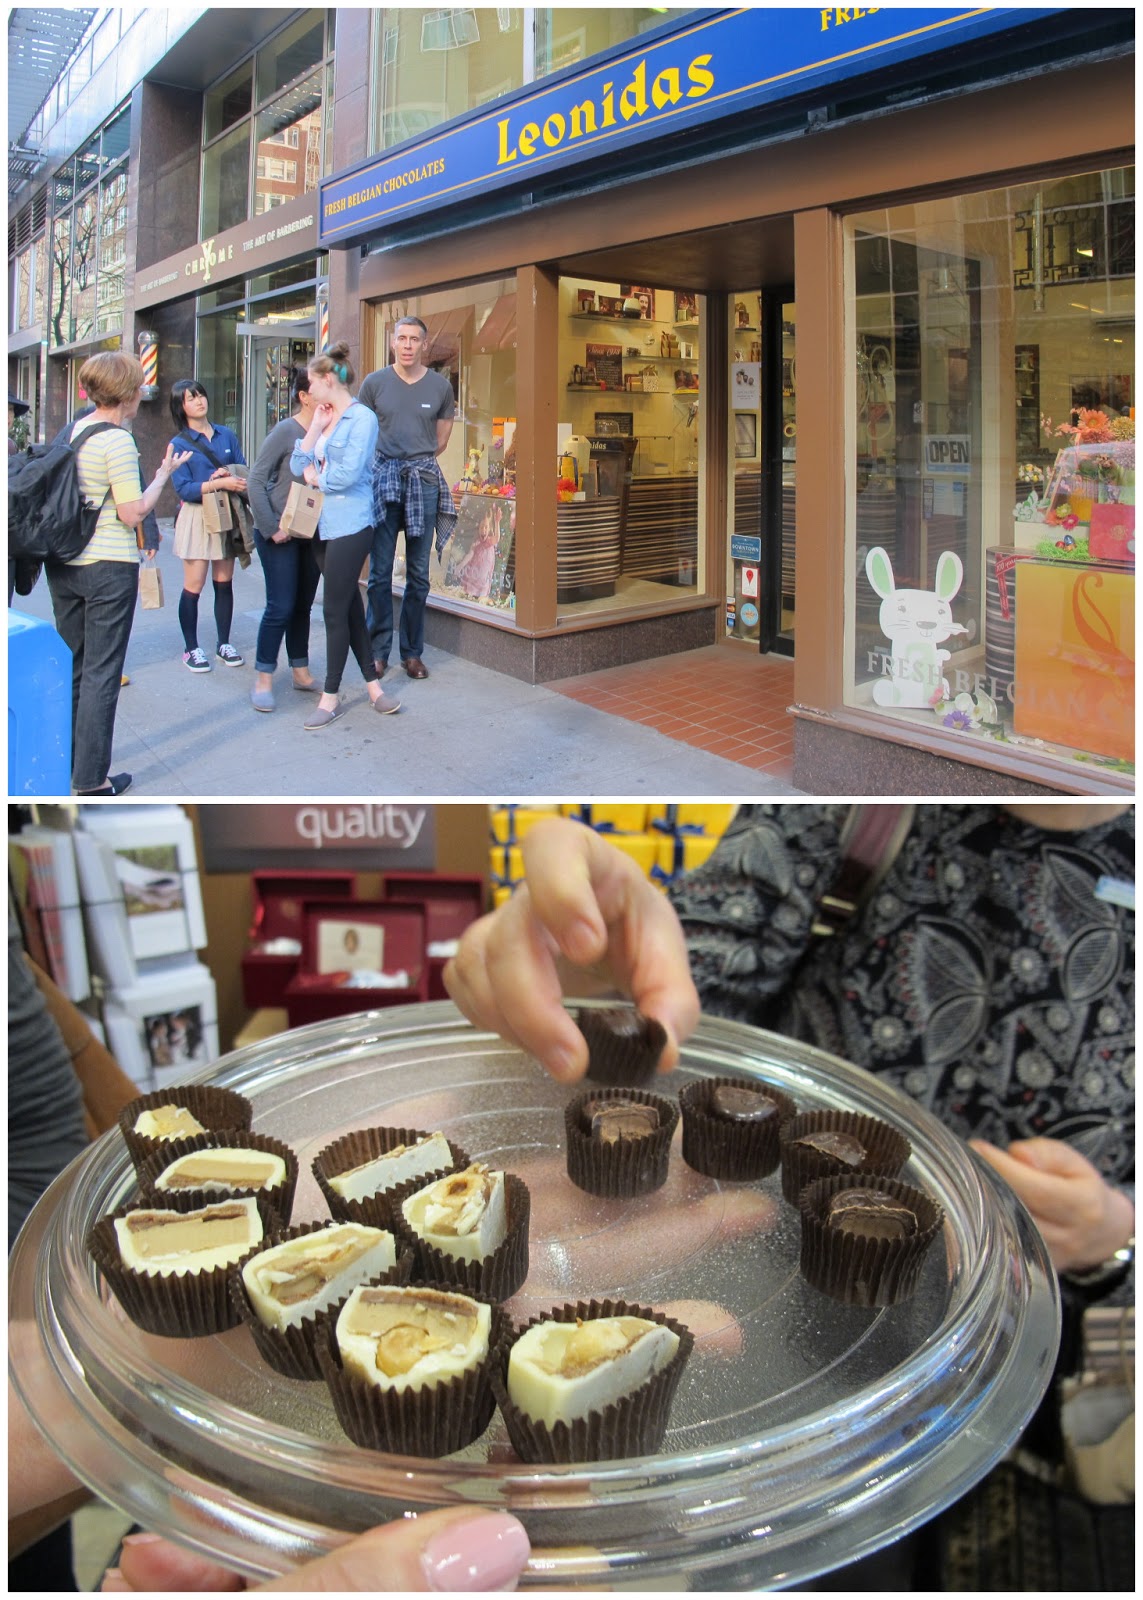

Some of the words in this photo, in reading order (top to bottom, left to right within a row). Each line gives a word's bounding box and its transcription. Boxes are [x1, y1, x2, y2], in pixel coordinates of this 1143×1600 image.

[820, 8, 880, 32] FRE
[496, 54, 715, 166] Leonidas
[324, 198, 346, 217] FRESH
[347, 183, 382, 209] BELGIAN
[383, 158, 445, 194] CHOCOLATES
[254, 234, 266, 247] ART
[266, 230, 276, 241] OF
[928, 440, 970, 464] OPEN
[732, 543, 759, 553] DOWNTOWN
[867, 651, 944, 688] FRESH
[296, 804, 427, 849] quality
